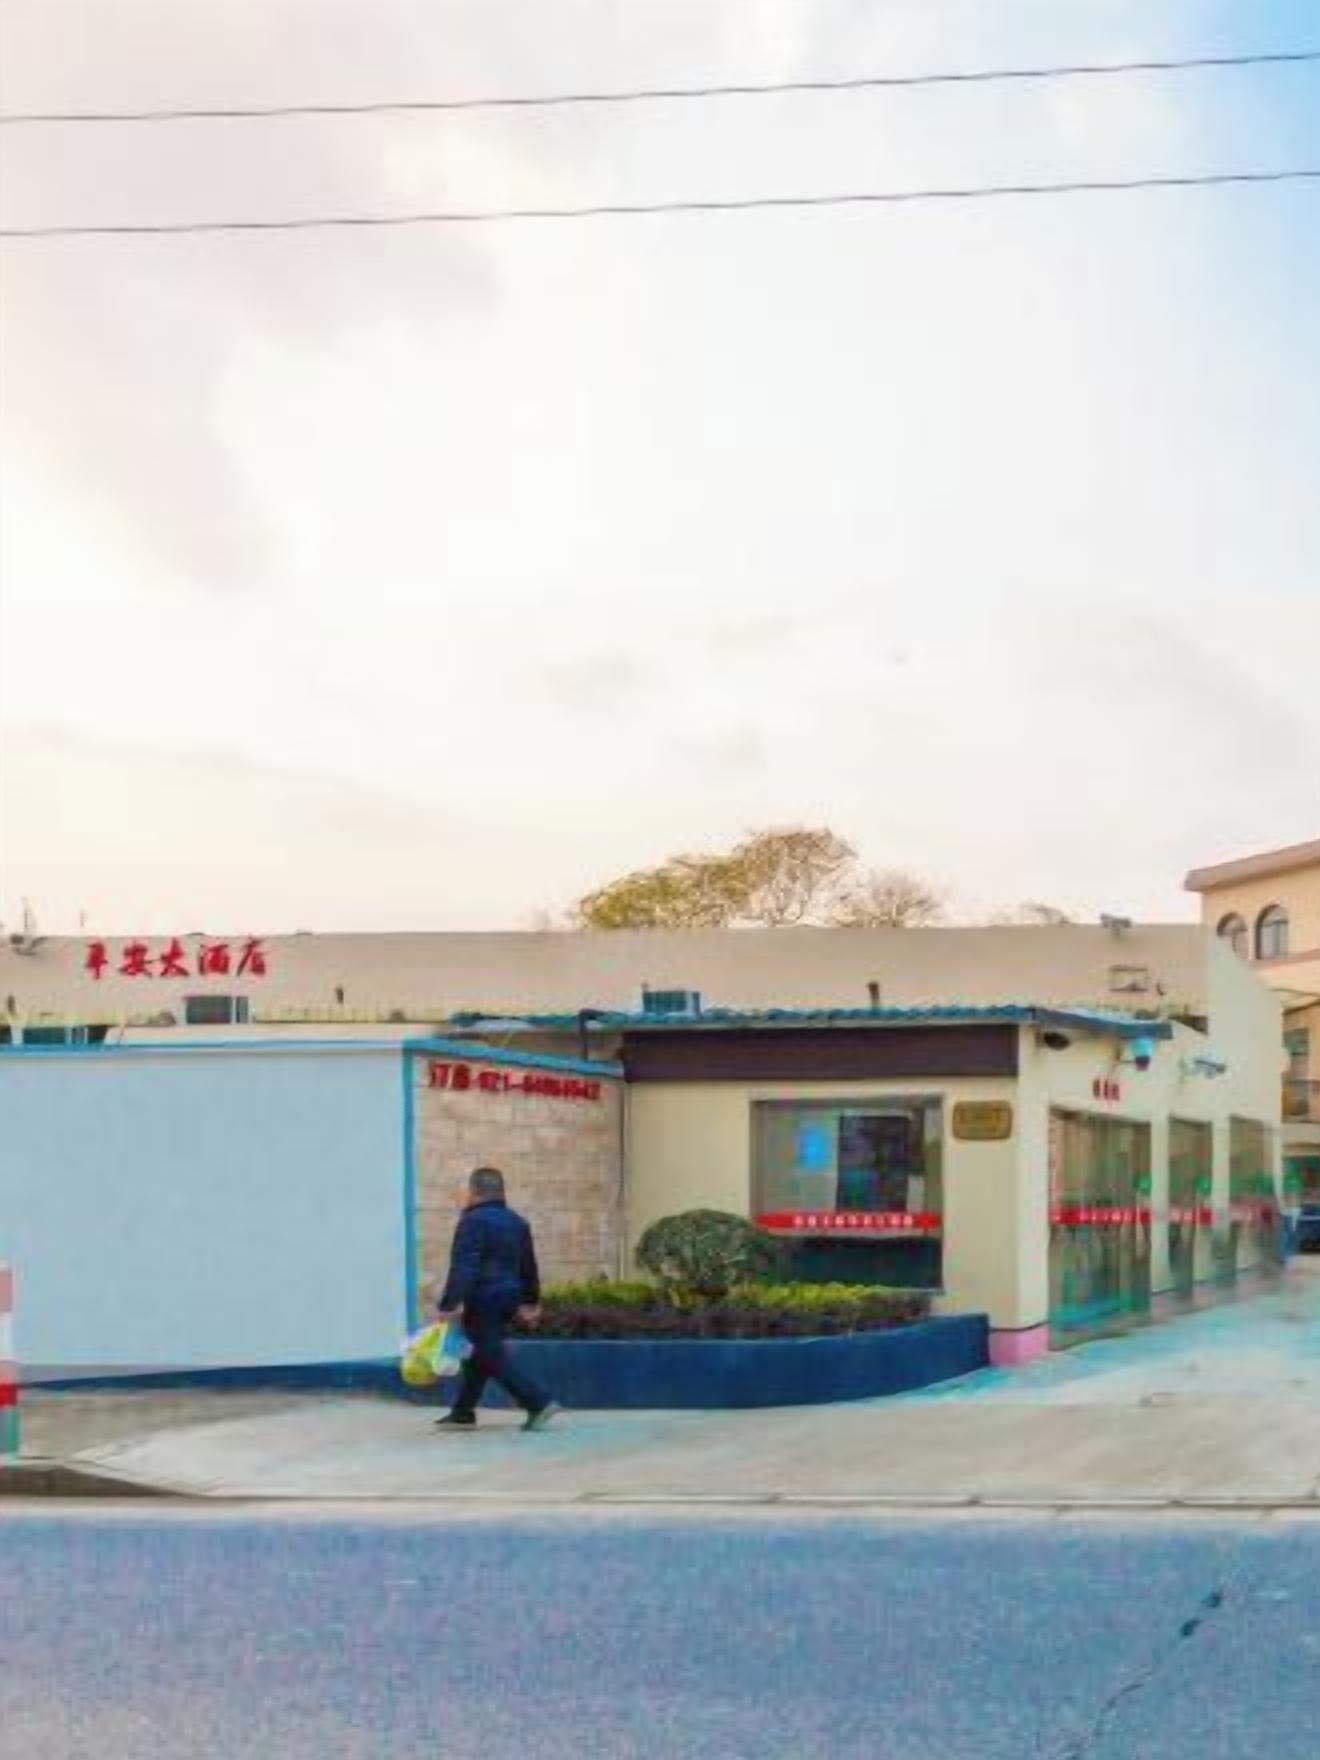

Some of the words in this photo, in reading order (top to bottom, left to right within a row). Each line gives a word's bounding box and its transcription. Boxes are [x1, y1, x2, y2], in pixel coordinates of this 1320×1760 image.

[85, 936, 267, 980] 平安大酒店
